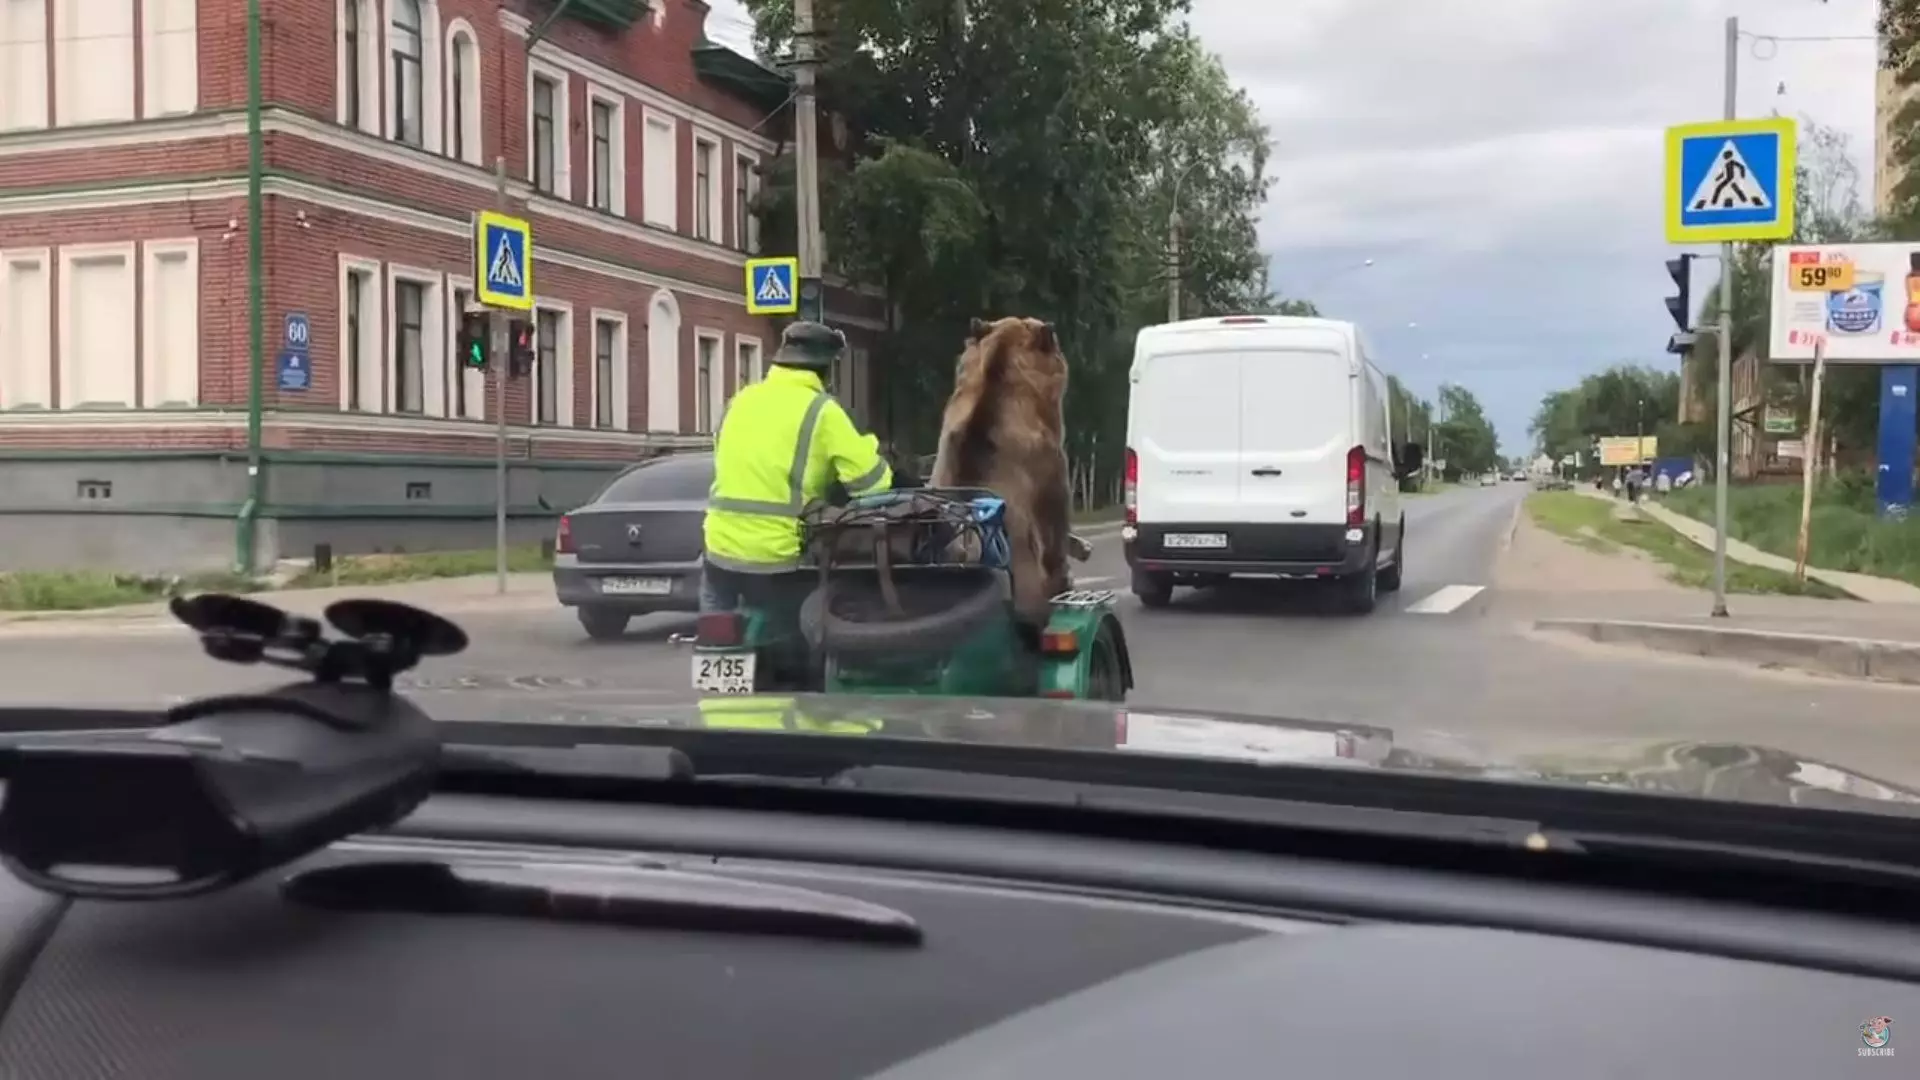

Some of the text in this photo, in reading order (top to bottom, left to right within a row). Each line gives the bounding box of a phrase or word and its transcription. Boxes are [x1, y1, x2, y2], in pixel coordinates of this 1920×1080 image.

[1800, 267, 1826, 287] 59
[289, 322, 306, 342] 60
[700, 659, 745, 677] 2135
